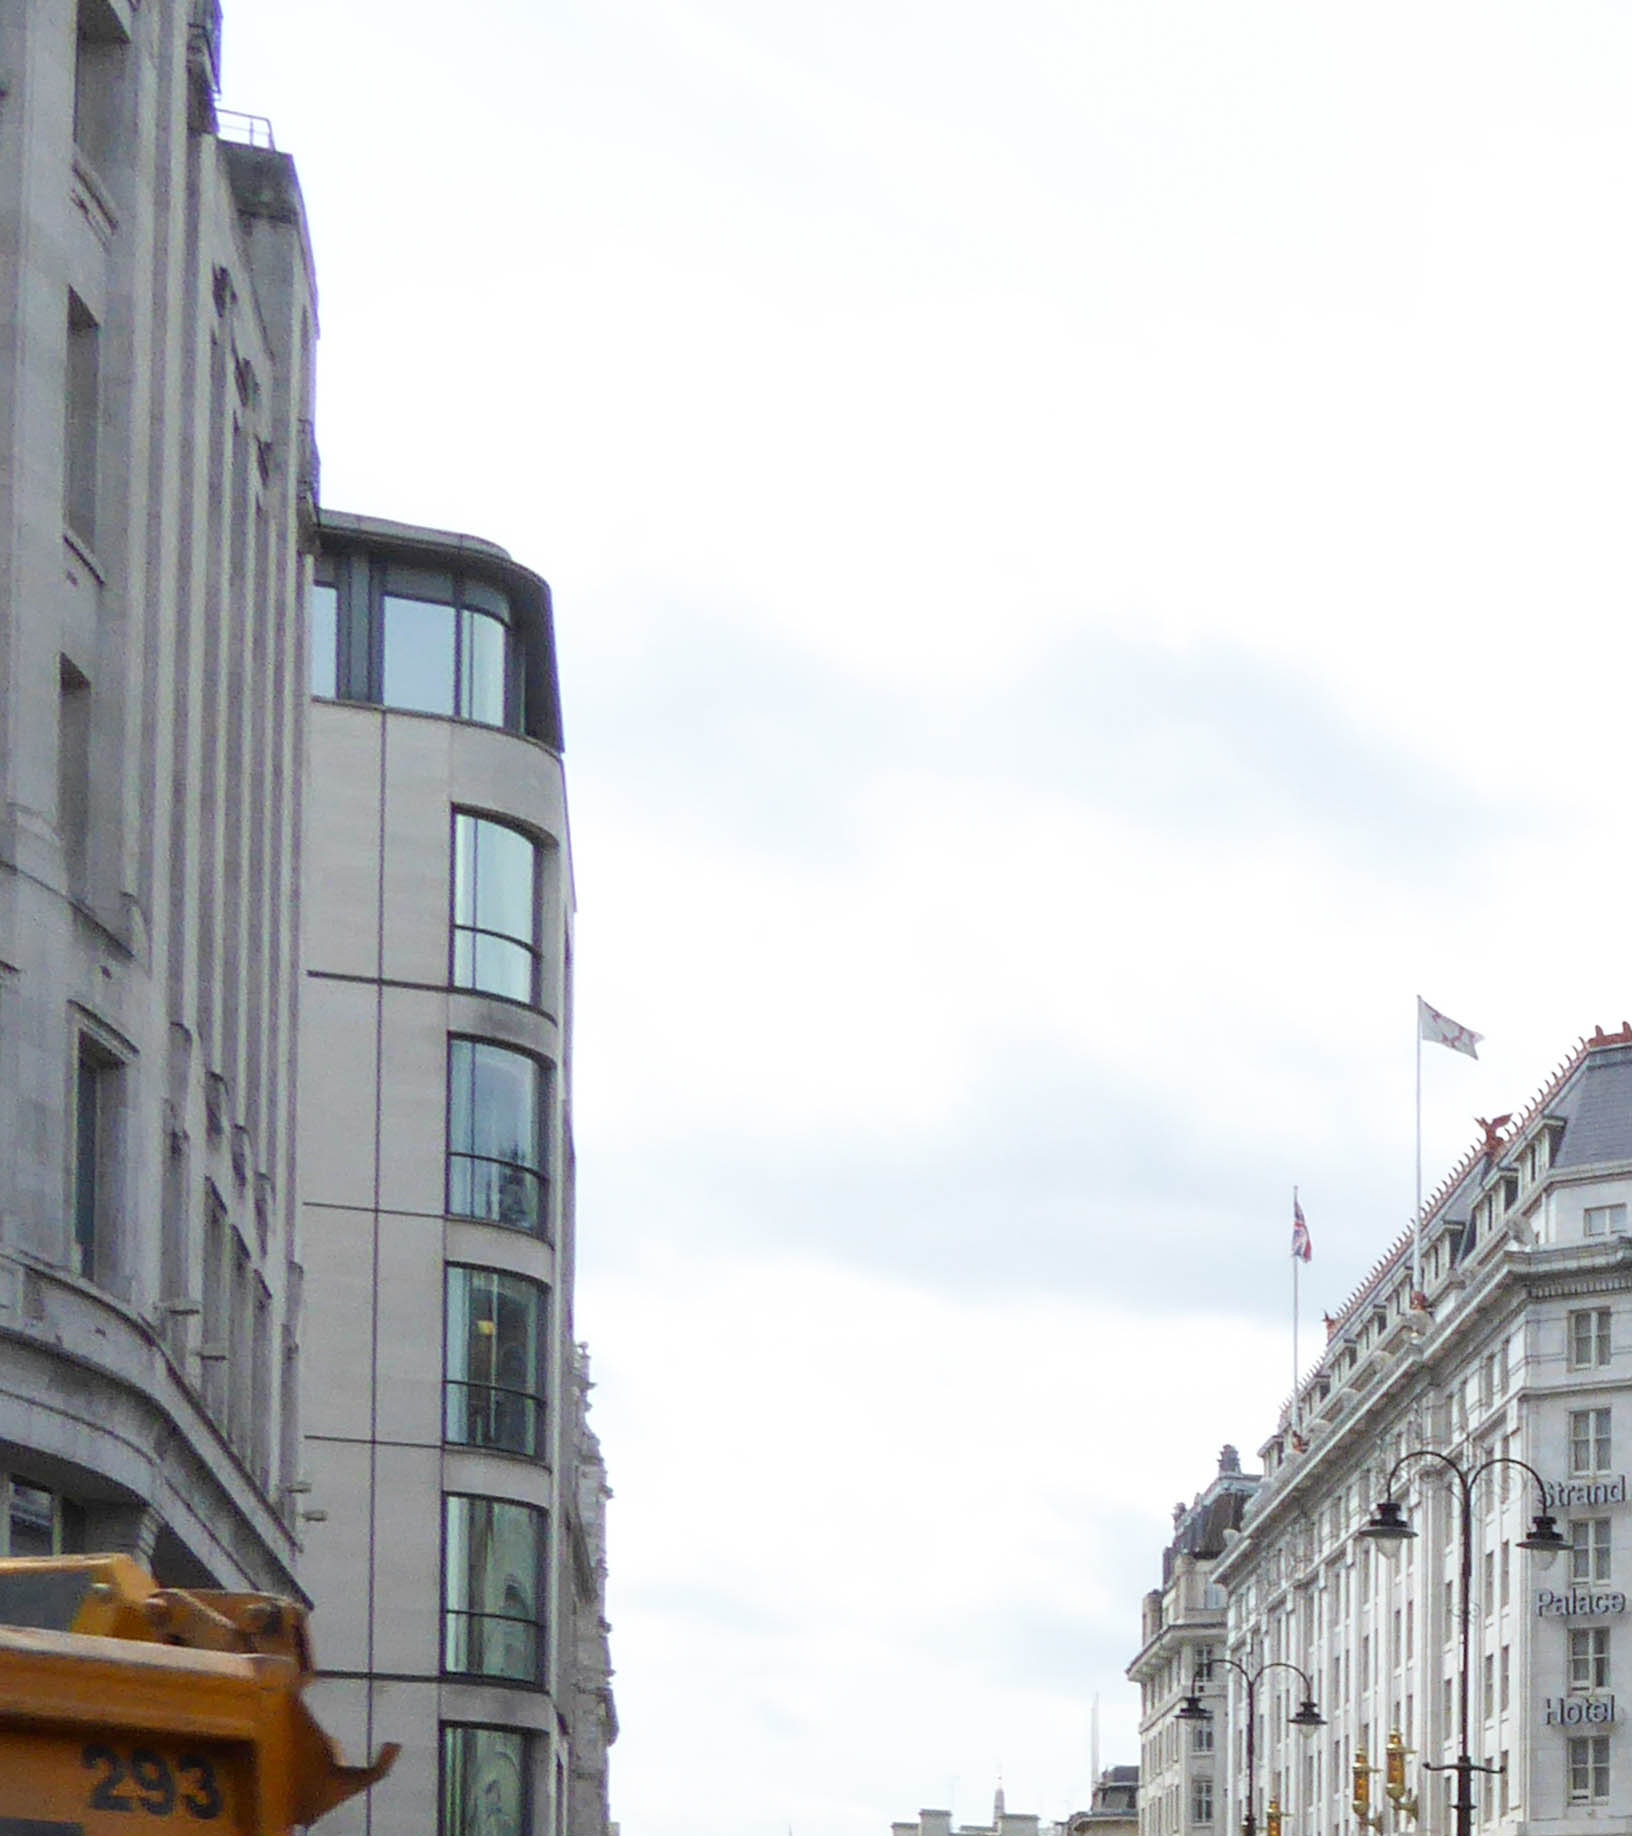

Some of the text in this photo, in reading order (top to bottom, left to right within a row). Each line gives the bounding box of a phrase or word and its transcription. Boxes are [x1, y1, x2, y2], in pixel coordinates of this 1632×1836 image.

[1545, 1474, 1627, 1508] Strand
[1537, 1587, 1627, 1617] Palace
[1545, 1695, 1617, 1725] Hotel
[80, 1743, 224, 1820] 293
